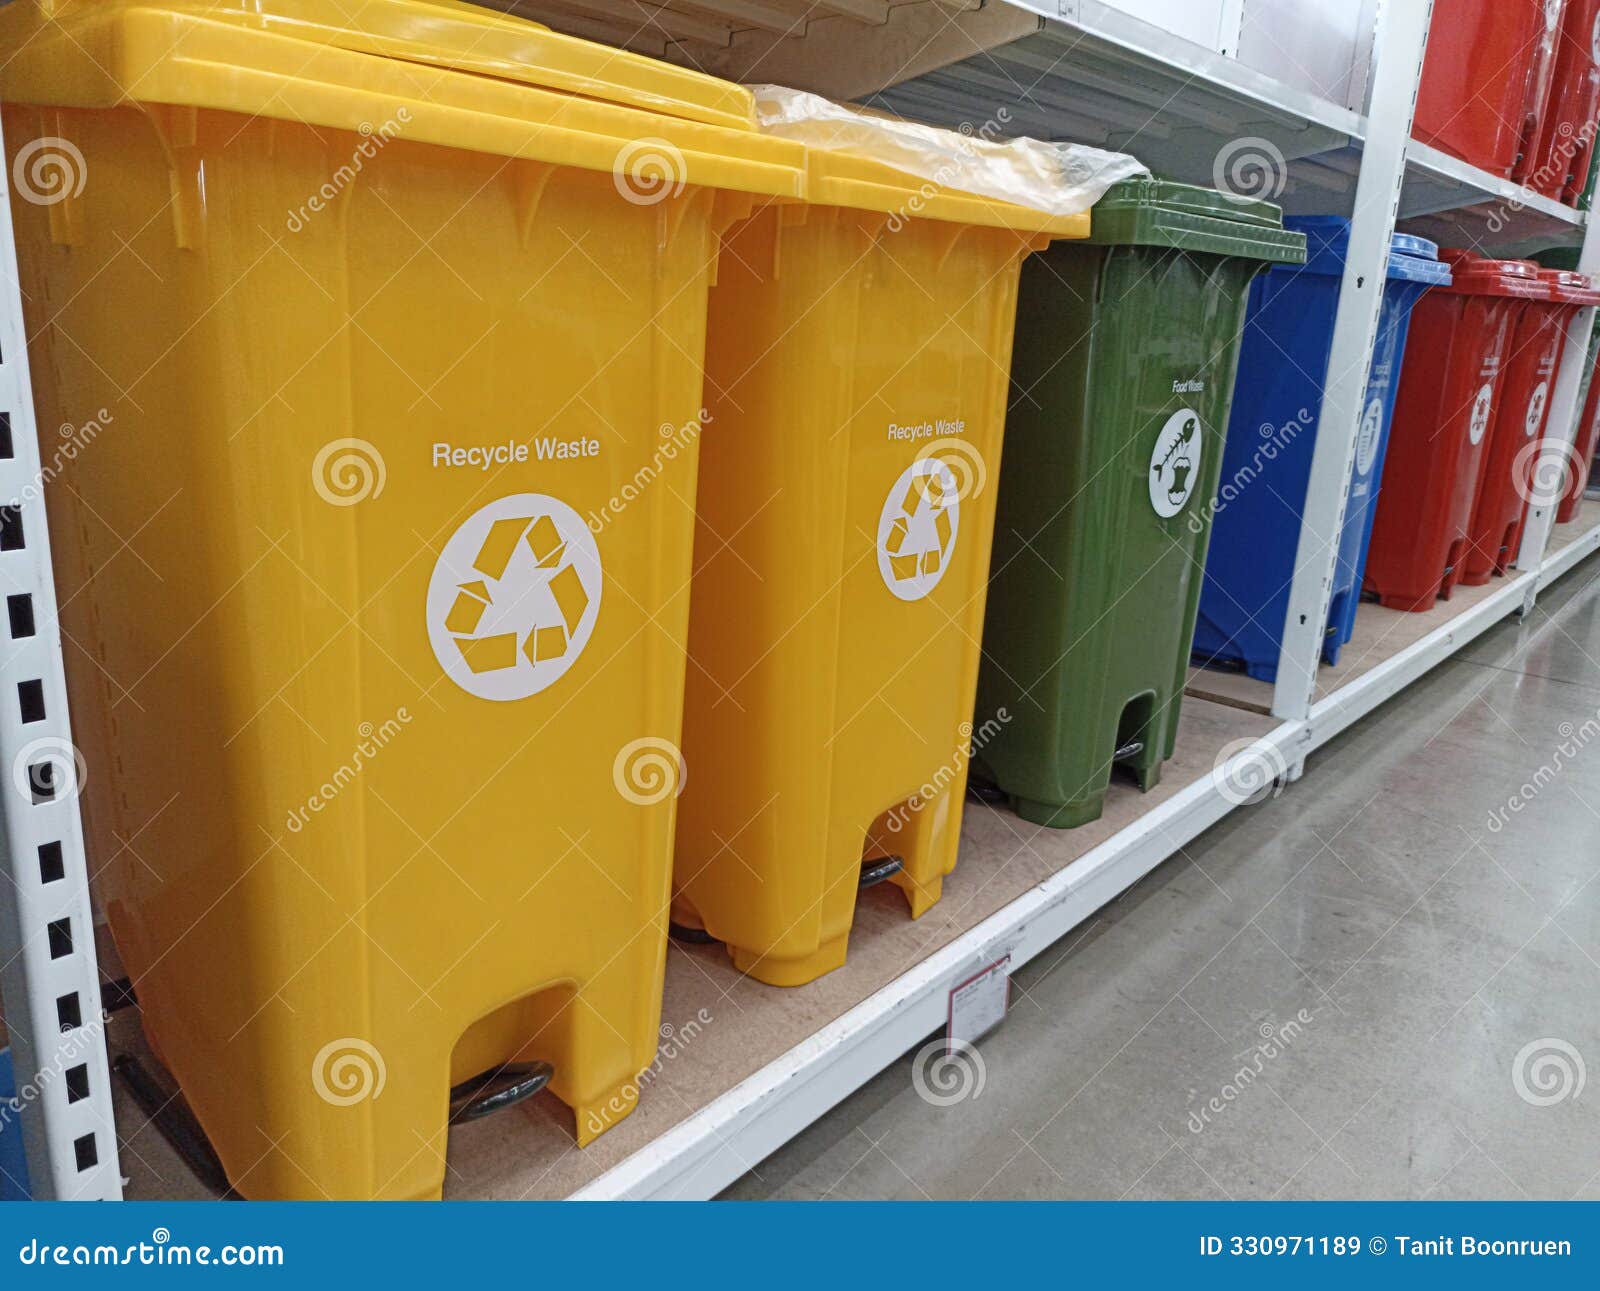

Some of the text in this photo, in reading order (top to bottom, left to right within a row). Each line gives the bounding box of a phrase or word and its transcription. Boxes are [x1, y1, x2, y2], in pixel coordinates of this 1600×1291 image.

[887, 419, 965, 443] Recycle Waste
[432, 436, 600, 471] Recycle Waste
